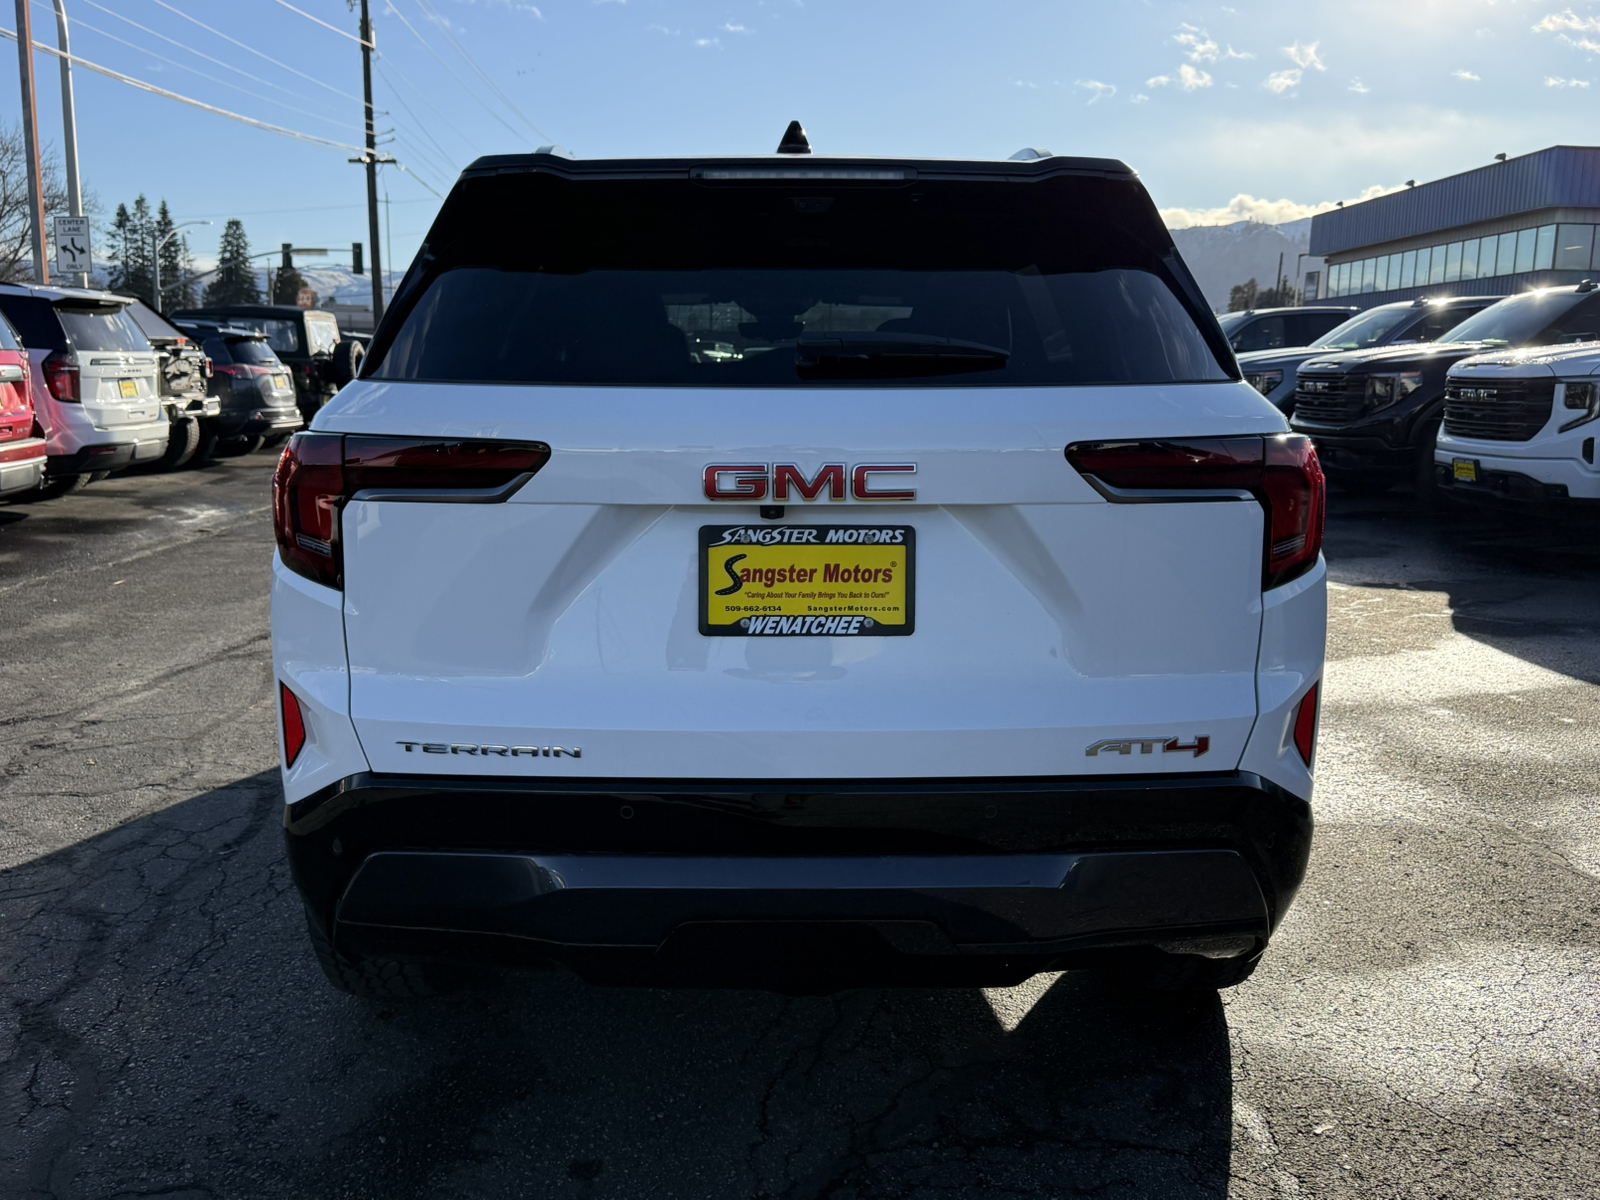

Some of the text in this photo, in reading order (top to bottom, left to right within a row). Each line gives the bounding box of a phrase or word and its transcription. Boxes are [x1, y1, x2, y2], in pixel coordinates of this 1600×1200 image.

[703, 462, 917, 501] GMC
[708, 526, 905, 547] SANGSTER MOTORS
[715, 553, 818, 596] Sangster
[766, 591, 783, 599] About
[784, 591, 798, 599] Your
[798, 591, 817, 600] Family
[817, 591, 836, 600] Brings
[837, 591, 848, 599] You
[849, 591, 863, 599] Back
[863, 591, 870, 599] to
[807, 605, 900, 613] SangsterMotors.com
[747, 616, 864, 635] WENATCHEE
[395, 741, 582, 758] TERRAIN
[1085, 733, 1210, 758] AT4
